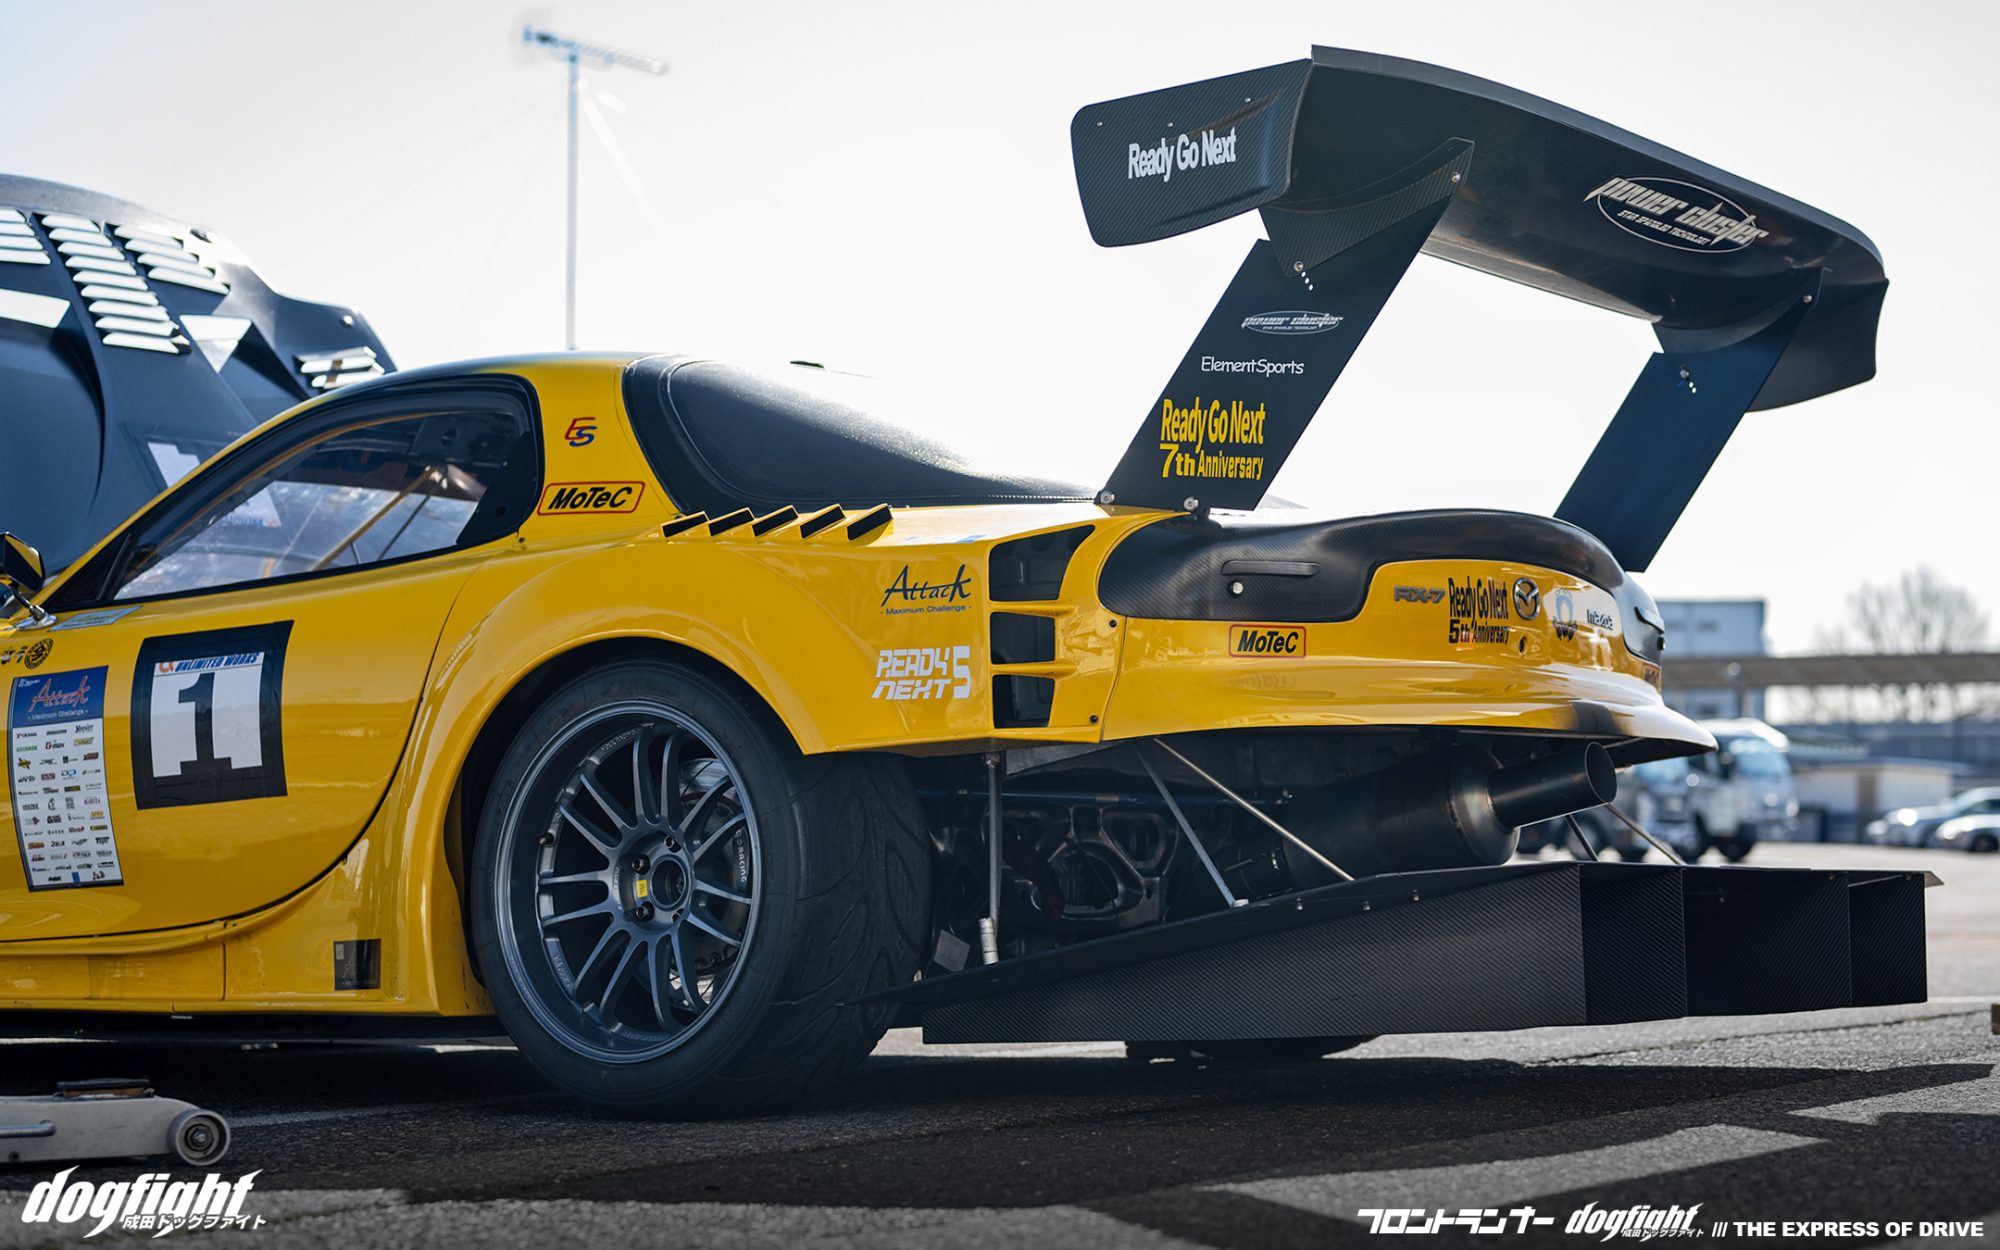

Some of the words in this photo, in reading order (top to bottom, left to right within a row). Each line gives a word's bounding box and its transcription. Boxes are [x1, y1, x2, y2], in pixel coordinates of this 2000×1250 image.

[1128, 138, 1174, 182] Ready
[1176, 133, 1199, 171] Go
[1201, 127, 1236, 167] Next
[1201, 356, 1304, 377] ElementSports
[1160, 397, 1207, 454] Ready
[1207, 400, 1228, 444] Go
[1229, 400, 1266, 444] Next
[1159, 443, 1195, 478] 7th
[1197, 450, 1264, 481] Anniversary
[547, 486, 633, 510] MoTeC
[880, 564, 972, 607] Attack
[1394, 586, 1446, 604] RX-7
[886, 608, 924, 616] Maximum
[926, 604, 966, 613] Challenge
[1448, 576, 1477, 629] Ready
[1476, 578, 1489, 619] Go
[1488, 579, 1509, 619] Next
[1237, 630, 1299, 653] MoTeC
[1448, 619, 1470, 644] 5th
[1472, 621, 1510, 645] Anniversary
[175, 656, 225, 672] UNLIMITED
[223, 653, 260, 667] WORKS
[875, 648, 950, 678] READY
[953, 645, 972, 699] 5
[871, 679, 952, 700] NEXT
[178, 671, 232, 775] 1
